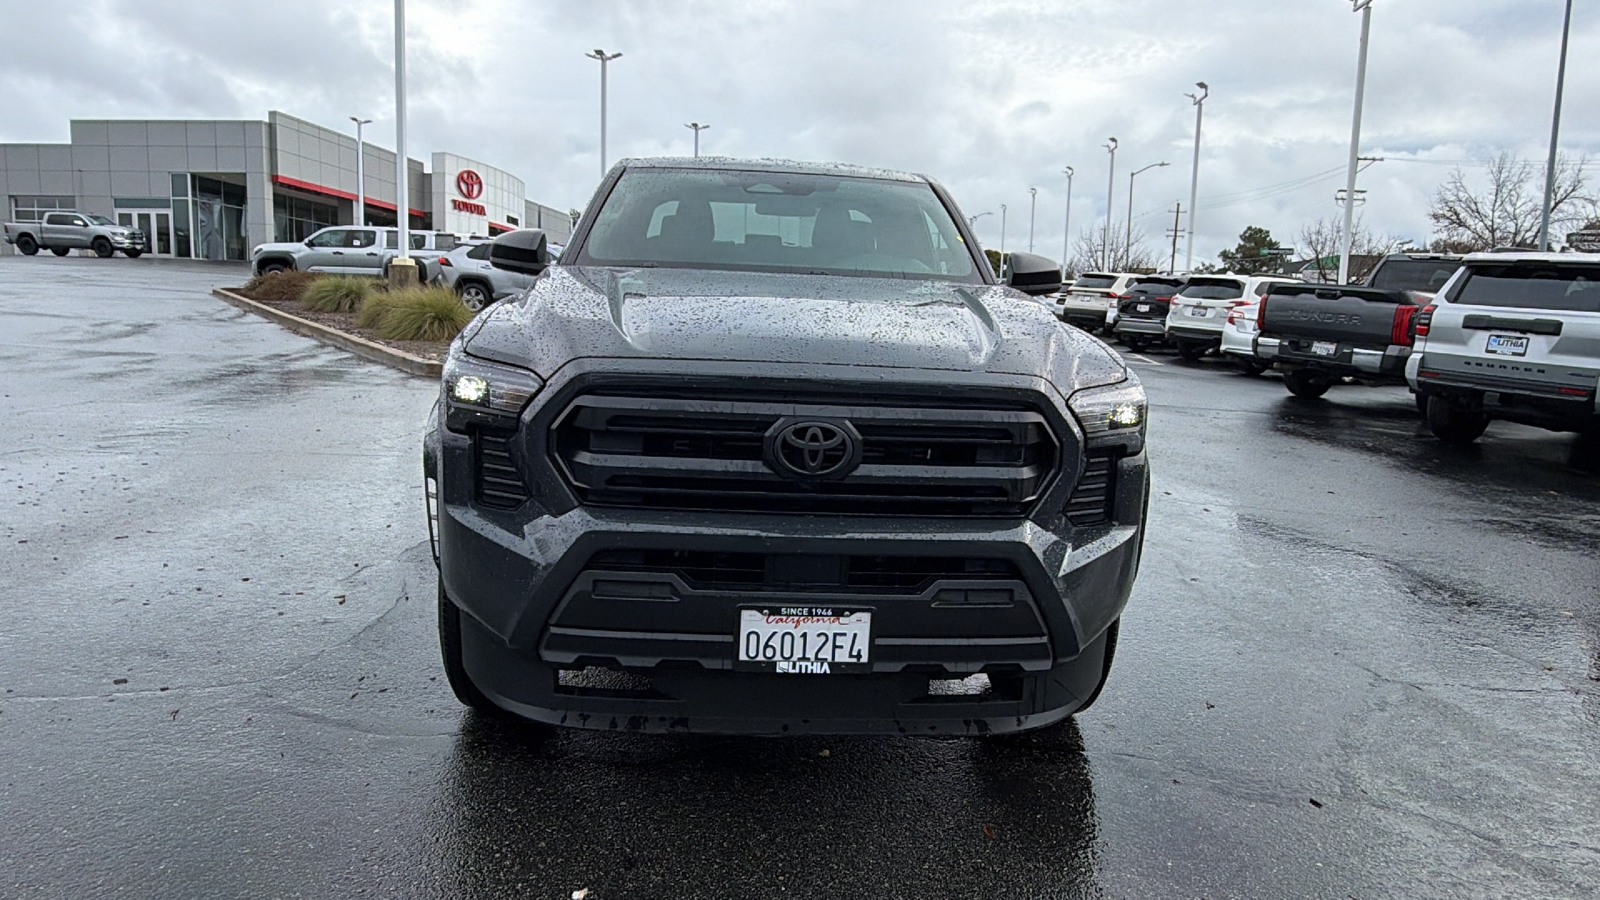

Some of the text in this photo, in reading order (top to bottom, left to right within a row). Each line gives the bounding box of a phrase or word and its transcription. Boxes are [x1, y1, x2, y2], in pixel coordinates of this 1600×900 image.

[452, 199, 487, 216] TOYOTA
[1289, 310, 1361, 325] TUNDRA
[1497, 339, 1524, 348] LITHIA
[766, 615, 849, 629] California
[745, 630, 863, 662] 06012F4
[789, 662, 830, 673] LITHIA
